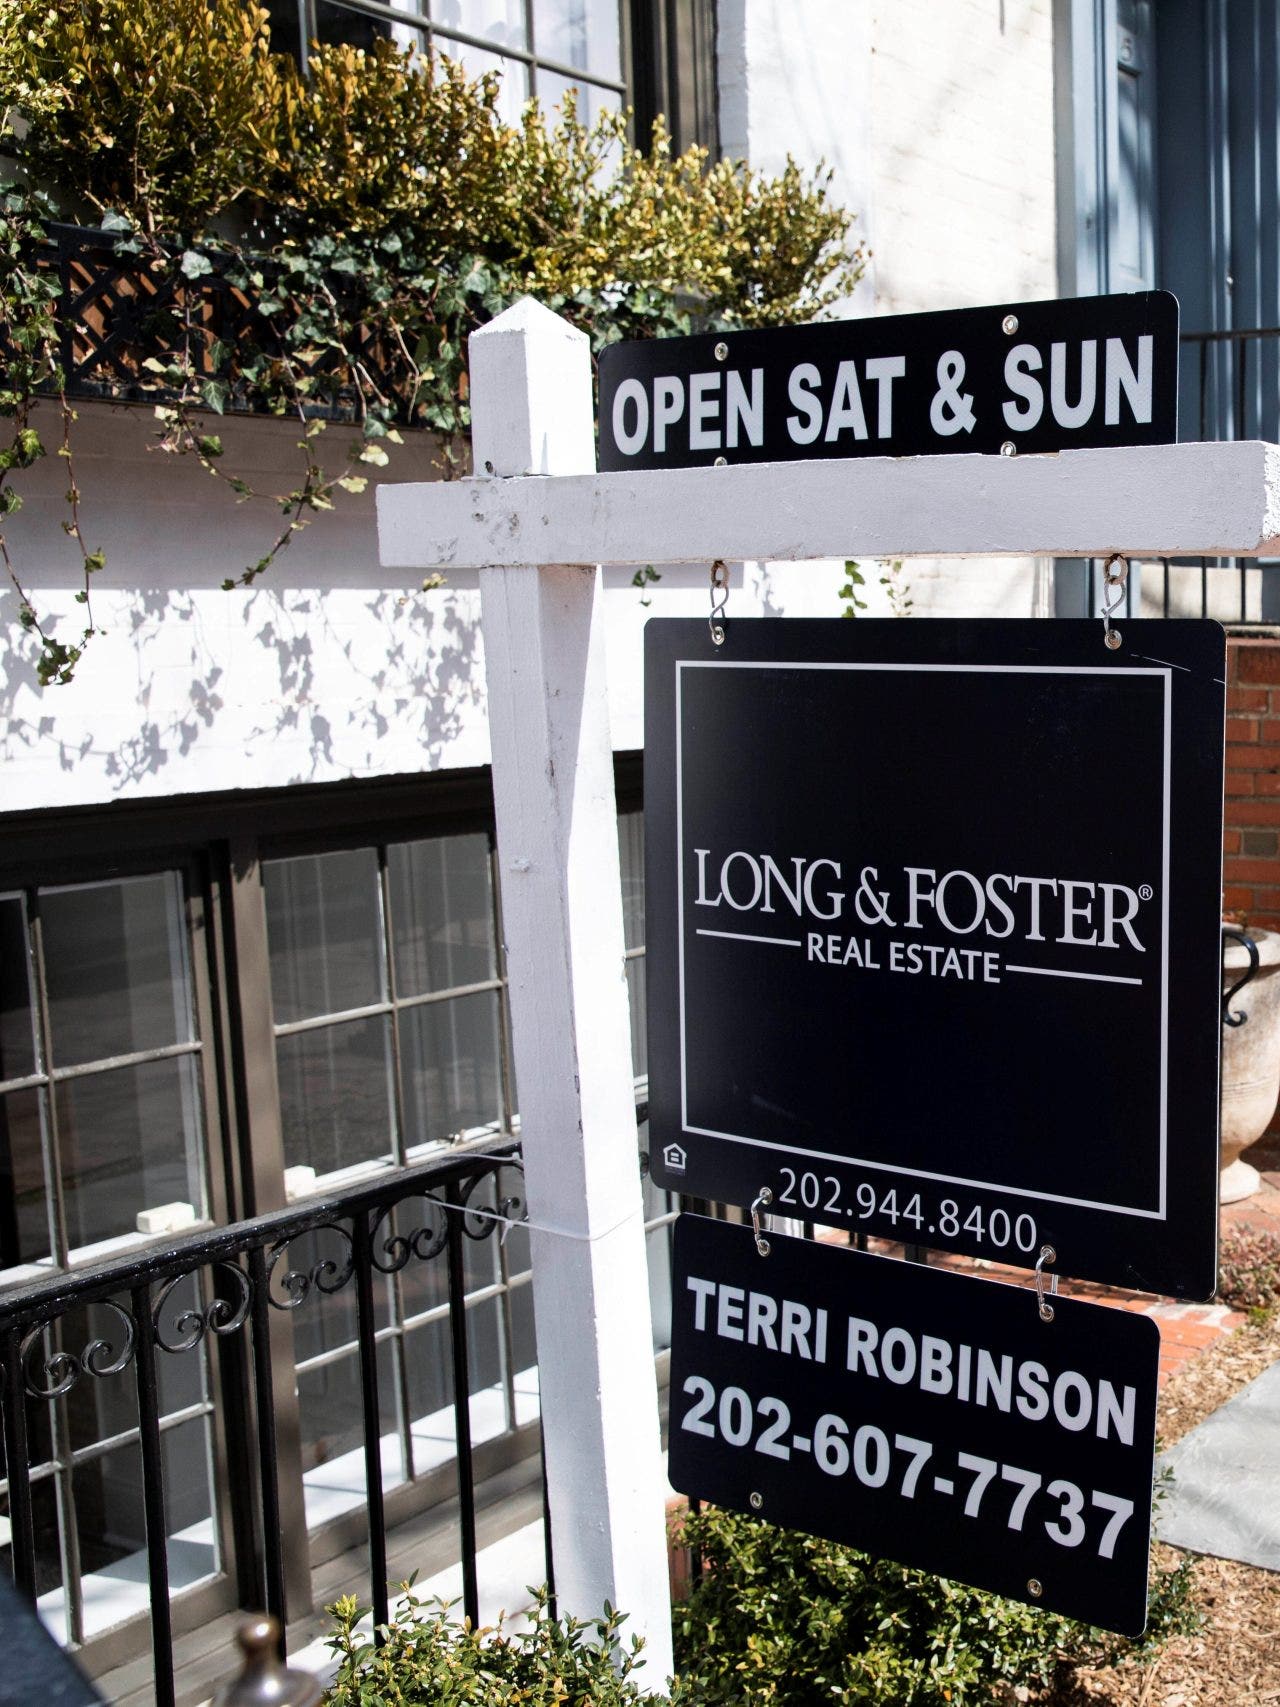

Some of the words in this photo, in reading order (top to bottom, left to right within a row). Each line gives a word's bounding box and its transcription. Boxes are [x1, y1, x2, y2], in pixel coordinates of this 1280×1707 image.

[612, 368, 764, 456] OPEN
[787, 356, 906, 445] SAT
[930, 350, 977, 436] &
[1002, 335, 1154, 432] SUN
[694, 848, 845, 920] LONG
[854, 866, 897, 927] &
[807, 932, 881, 969] REAL
[889, 941, 1001, 984] ESTATE
[779, 1167, 1037, 1252] 202.944.8400
[687, 1276, 828, 1364] TERRI
[846, 1317, 1137, 1446] ROBINSON
[681, 1376, 1135, 1560] 202-607-7737
